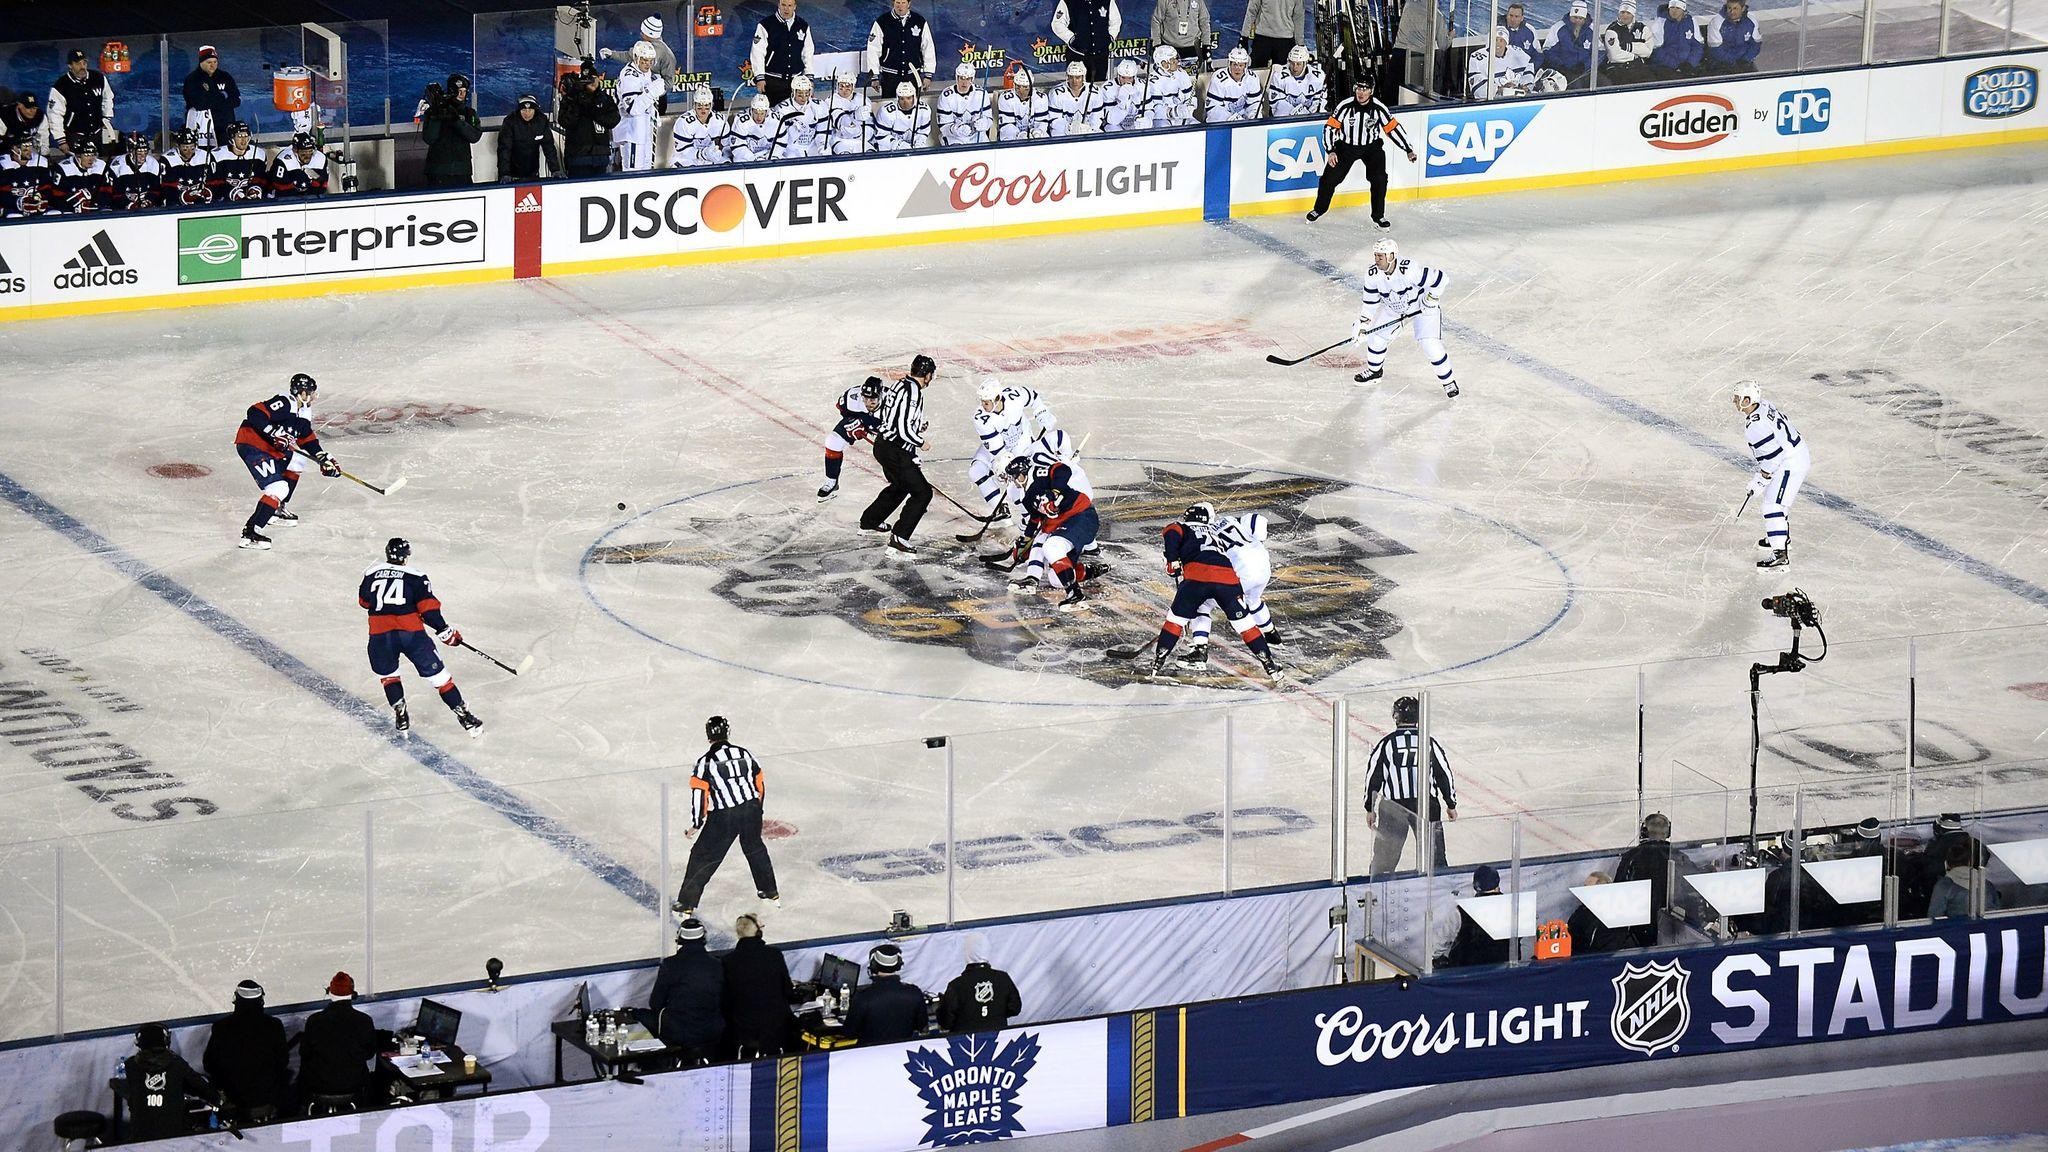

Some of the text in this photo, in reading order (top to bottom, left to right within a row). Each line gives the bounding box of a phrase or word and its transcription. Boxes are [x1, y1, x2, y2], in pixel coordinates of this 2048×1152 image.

[707, 26, 715, 35] G
[1034, 45, 1067, 57] DRAF
[1109, 38, 1148, 51] DRAFT
[961, 49, 1006, 63] DRAFT
[1038, 53, 1067, 64] KING
[1110, 48, 1147, 58] KINGS
[114, 63, 122, 71] G
[673, 72, 712, 83] DRAFT
[1216, 71, 1229, 83] 51
[1976, 70, 2029, 92] ROLD
[92, 87, 102, 97] W
[294, 88, 304, 98] G
[1307, 84, 1315, 94] A
[884, 102, 896, 112] 19
[1969, 87, 2032, 113] GOLD
[1639, 92, 1831, 139] Glidden by PPG
[1427, 120, 1515, 166] SAP
[1267, 135, 1327, 181] SA
[949, 160, 1180, 213] Coors LIGHT
[515, 203, 542, 213] adidas
[579, 176, 848, 244] DISCOVER
[197, 214, 479, 265] enterprise
[1399, 259, 1411, 275] 46
[53, 265, 139, 290] adidas
[975, 409, 990, 425] 24
[254, 459, 276, 478] W
[374, 569, 405, 579] CARLSON
[370, 579, 407, 612] 74
[725, 760, 742, 777] 11
[818, 806, 1316, 882] GEICO
[1550, 943, 1560, 953] G
[981, 1005, 988, 1017] 5
[1628, 983, 1675, 1036] NHL
[1314, 1000, 1590, 1066] Coors LIGHT
[928, 1065, 1016, 1098] TORONTO
[147, 1094, 163, 1107] 100
[943, 1087, 1002, 1110] MAPLE
[943, 1105, 1002, 1128] LEAFS
